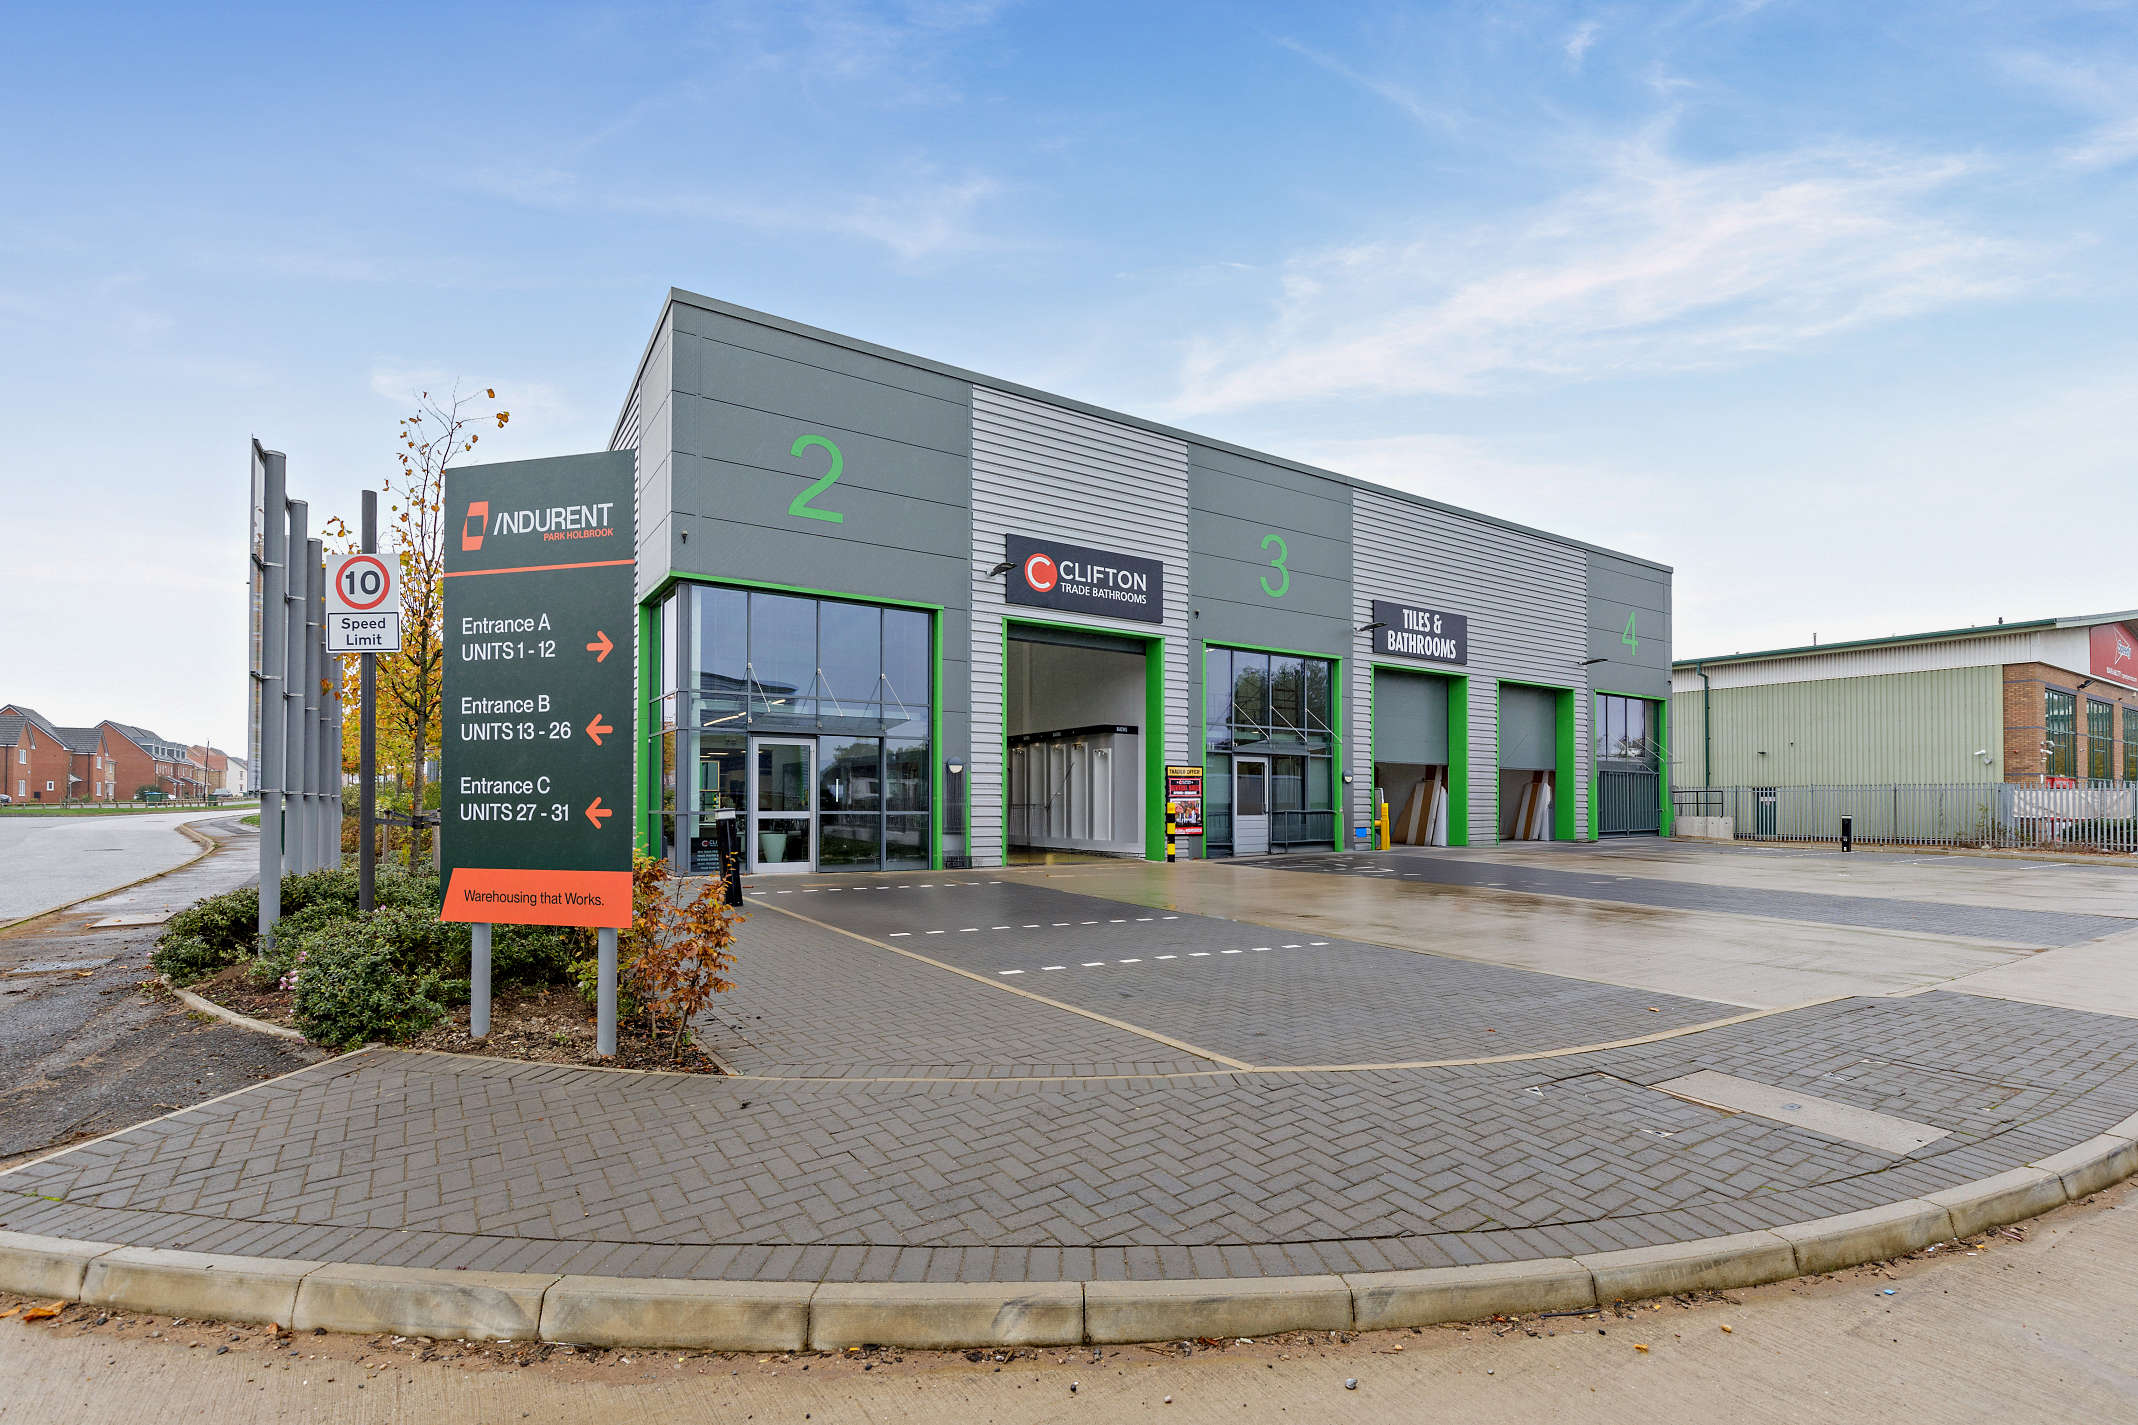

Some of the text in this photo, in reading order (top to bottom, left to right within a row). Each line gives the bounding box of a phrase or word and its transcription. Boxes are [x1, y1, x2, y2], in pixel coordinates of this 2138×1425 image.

[788, 434, 844, 524] 2
[543, 527, 614, 542] PARK HOLBROOK
[1060, 560, 1147, 592] CLIFTON
[1260, 534, 1290, 598] 3
[345, 570, 381, 595] 10
[1060, 582, 1147, 605] TRADE BATHROOMS
[341, 617, 386, 632] Speed
[462, 612, 551, 635] Entrance A
[1402, 608, 1442, 634] TILES &
[346, 634, 382, 646] Limit
[1387, 630, 1457, 659] BATHROOMS
[1621, 611, 1639, 657] 4
[462, 641, 514, 661] UNITS
[517, 641, 524, 659] 1
[538, 640, 556, 658] 12
[461, 694, 550, 715] Entrance B
[461, 722, 514, 741] UNITS
[516, 722, 535, 740] 13
[549, 721, 572, 739] 26
[460, 776, 551, 794] Entrance C
[460, 803, 513, 821] UNITS
[516, 803, 537, 821] 27
[551, 803, 569, 821] 31
[464, 889, 605, 907] Warehousing that Works.
